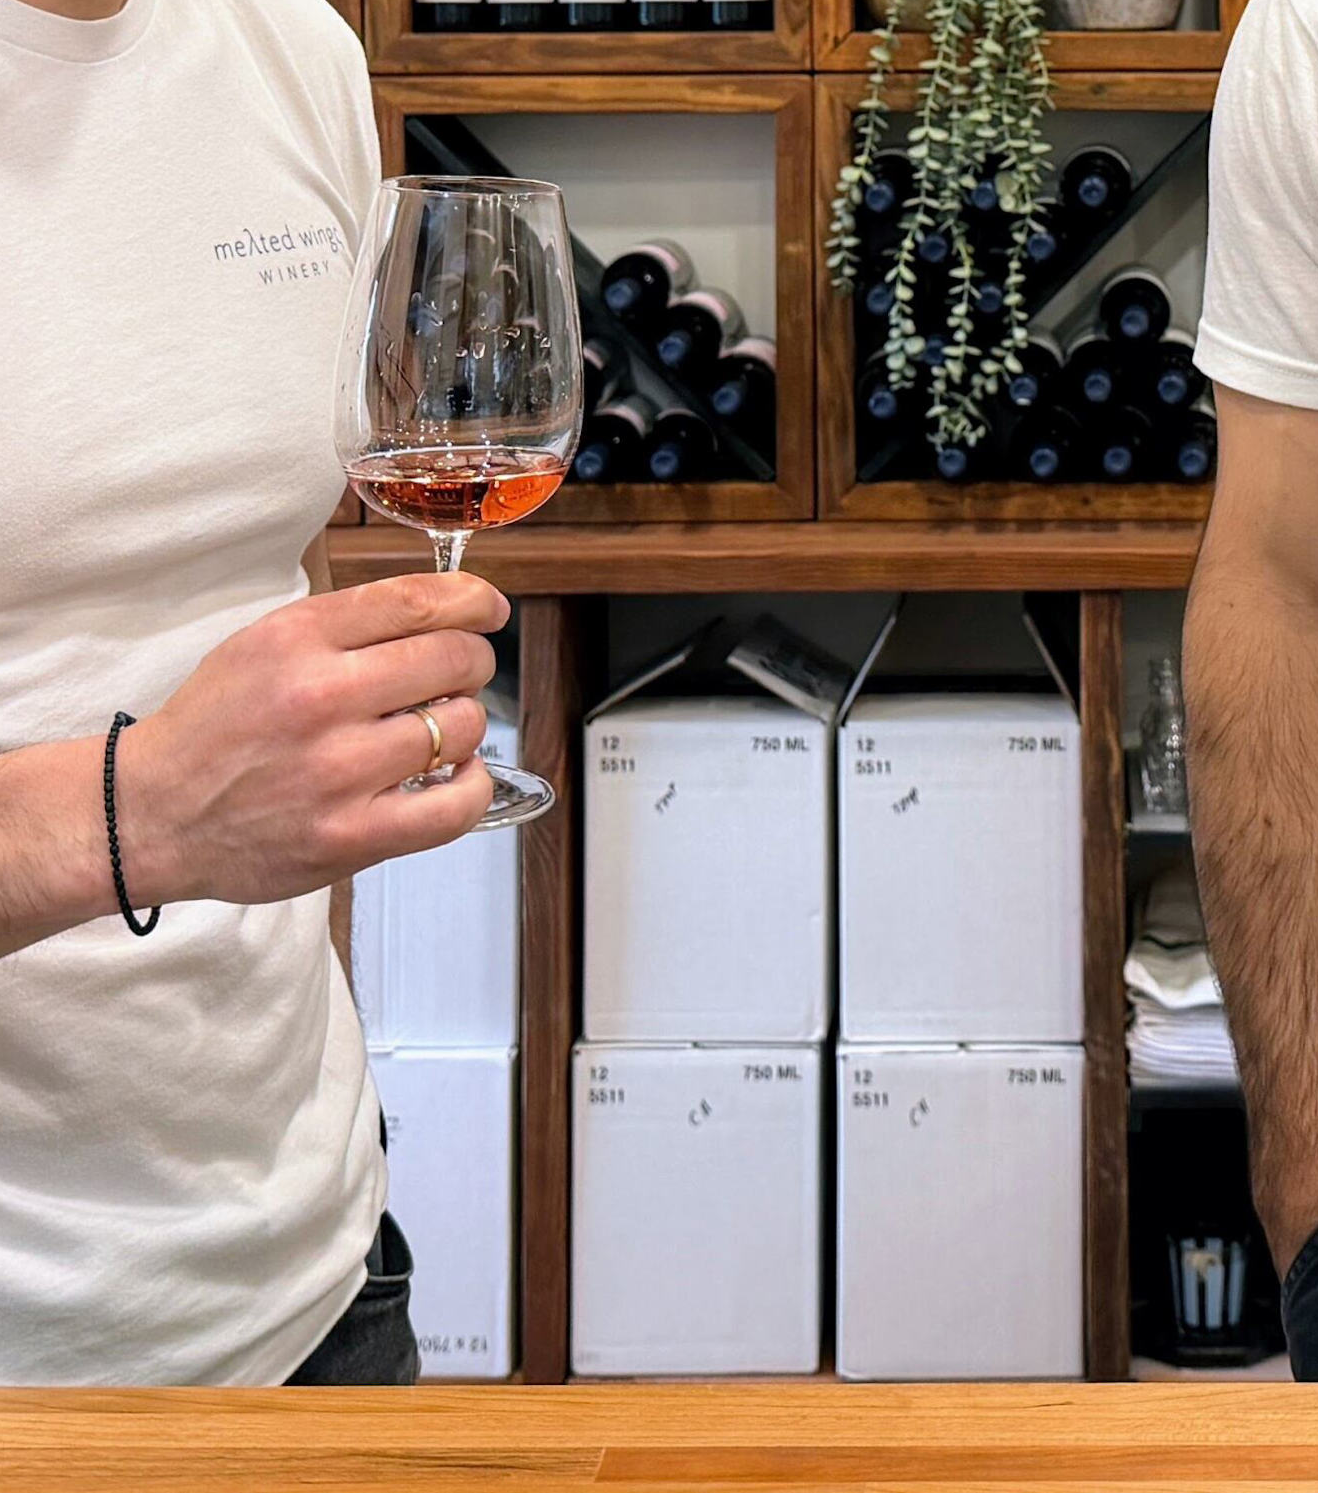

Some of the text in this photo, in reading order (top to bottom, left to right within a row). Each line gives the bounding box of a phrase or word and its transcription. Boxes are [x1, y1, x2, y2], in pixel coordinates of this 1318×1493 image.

[258, 259, 330, 285] WINERY
[600, 735, 810, 752] 12 750 ML
[856, 736, 1067, 752] 12 750 ML
[600, 758, 636, 773] 5511
[854, 760, 892, 775] 5511
[589, 1065, 802, 1081] 12 750 ML
[853, 1068, 1067, 1085] 12 750 ML
[588, 1088, 625, 1104] 5511
[852, 1091, 889, 1107] 5511
